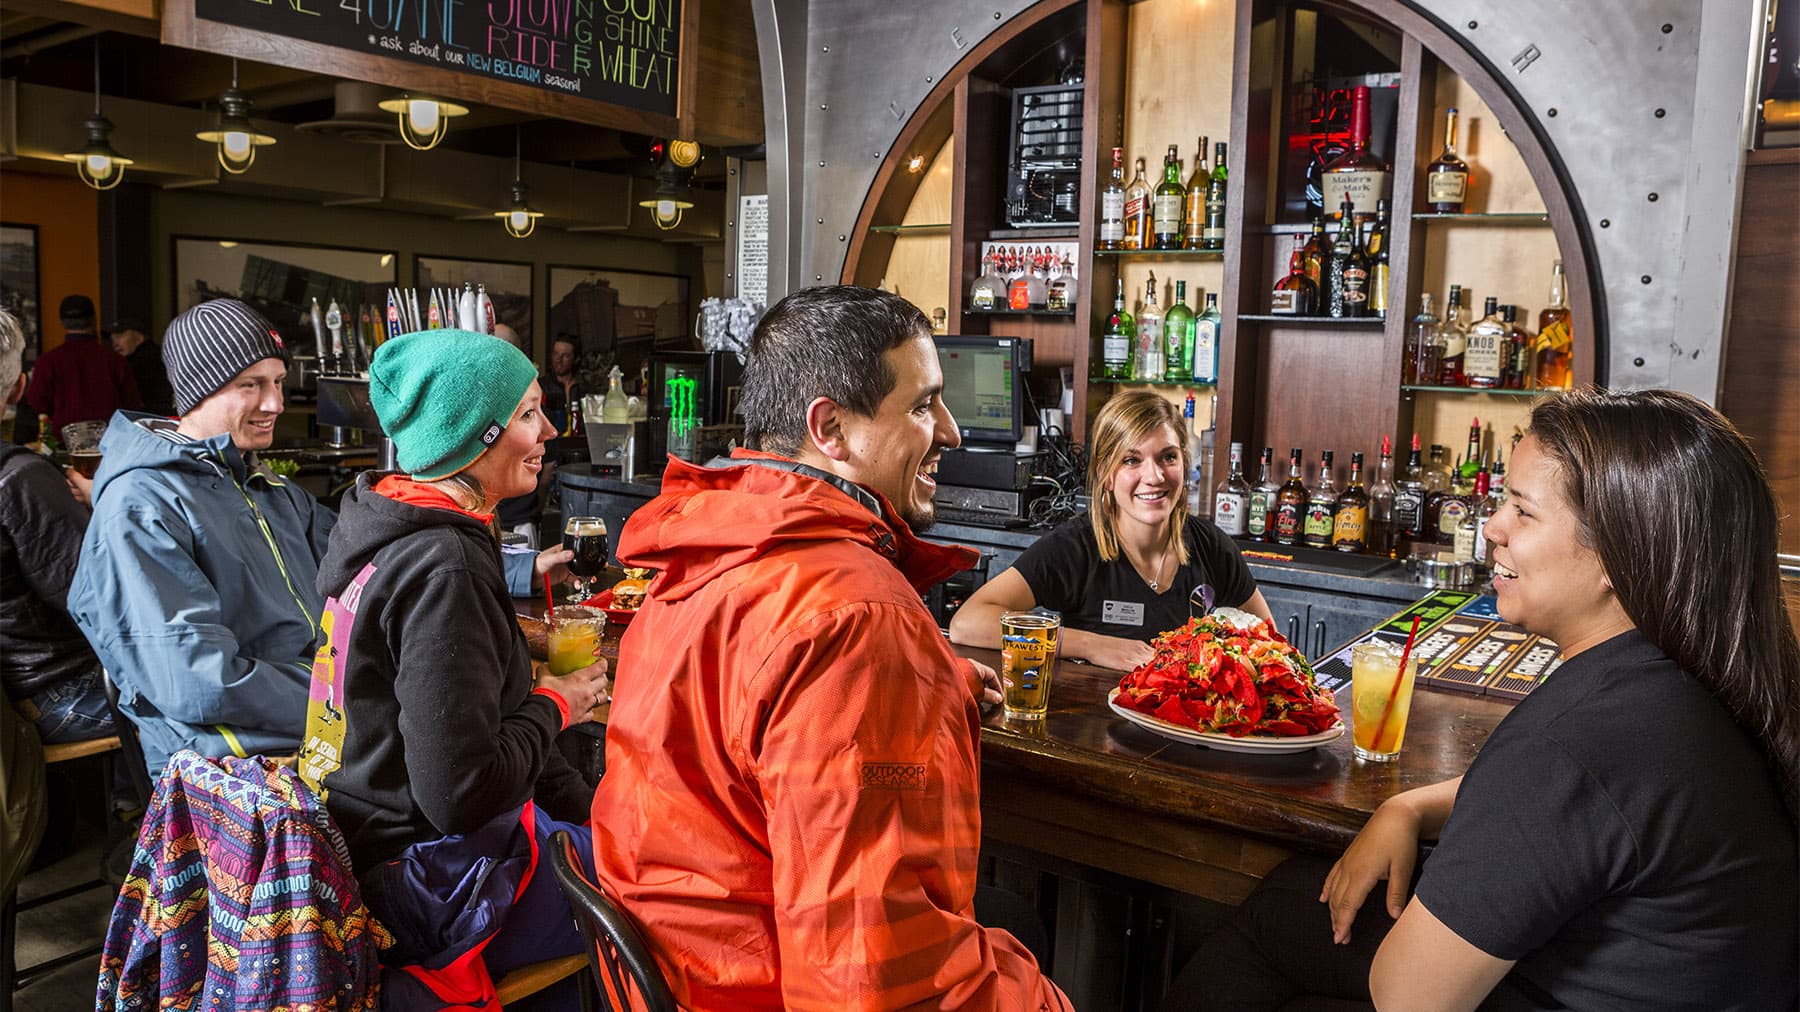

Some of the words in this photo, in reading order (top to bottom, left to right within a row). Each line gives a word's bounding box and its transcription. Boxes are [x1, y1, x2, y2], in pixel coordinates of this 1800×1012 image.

[487, 24, 570, 73] RIDE
[604, 13, 674, 56] SHINE
[380, 34, 404, 52] ask
[408, 40, 441, 62] about
[466, 52, 492, 73] NEW
[493, 59, 542, 84] BELGIUM
[543, 72, 582, 93] seasonal
[599, 40, 678, 96] WHEAT
[1332, 175, 1371, 184] Maker's
[1466, 336, 1495, 349] KNOB
[862, 765, 925, 777] OUTDOOR
